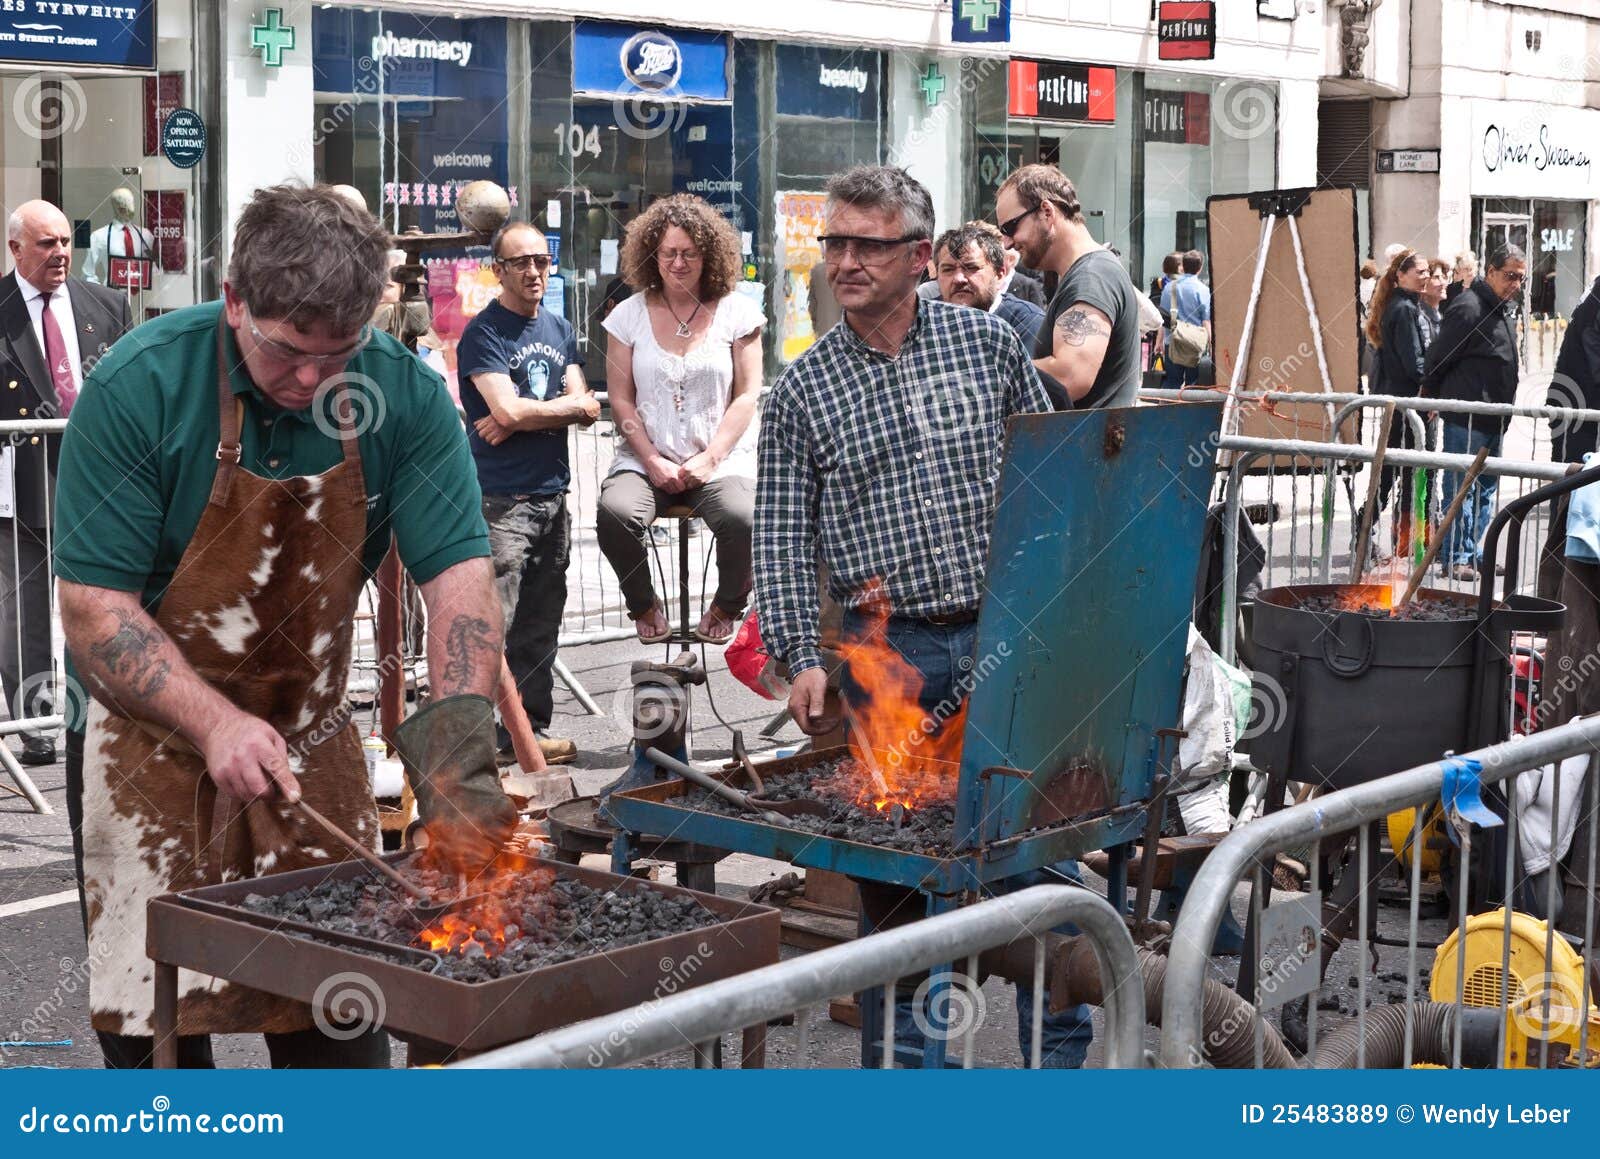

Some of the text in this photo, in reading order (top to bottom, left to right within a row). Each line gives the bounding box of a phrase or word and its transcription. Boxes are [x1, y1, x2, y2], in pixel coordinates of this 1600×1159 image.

[36, 1, 136, 20] TYRWHITT
[1161, 21, 1208, 38] PERFUME
[57, 35, 97, 46] LONDON
[371, 31, 472, 66] pharmacy
[819, 64, 868, 92] beauty
[1038, 75, 1088, 106] PERFUME
[176, 118, 193, 126] NOW
[1144, 98, 1184, 133] RFUME
[170, 127, 198, 136] OPEN ON
[554, 123, 602, 159] 104
[166, 139, 203, 148] SATURDAY
[1483, 124, 1591, 184] Oliver Sweeney
[433, 152, 492, 168] welcome
[686, 178, 743, 192] welcome
[1541, 228, 1575, 252] SALE
[1223, 720, 1231, 744] Solid
